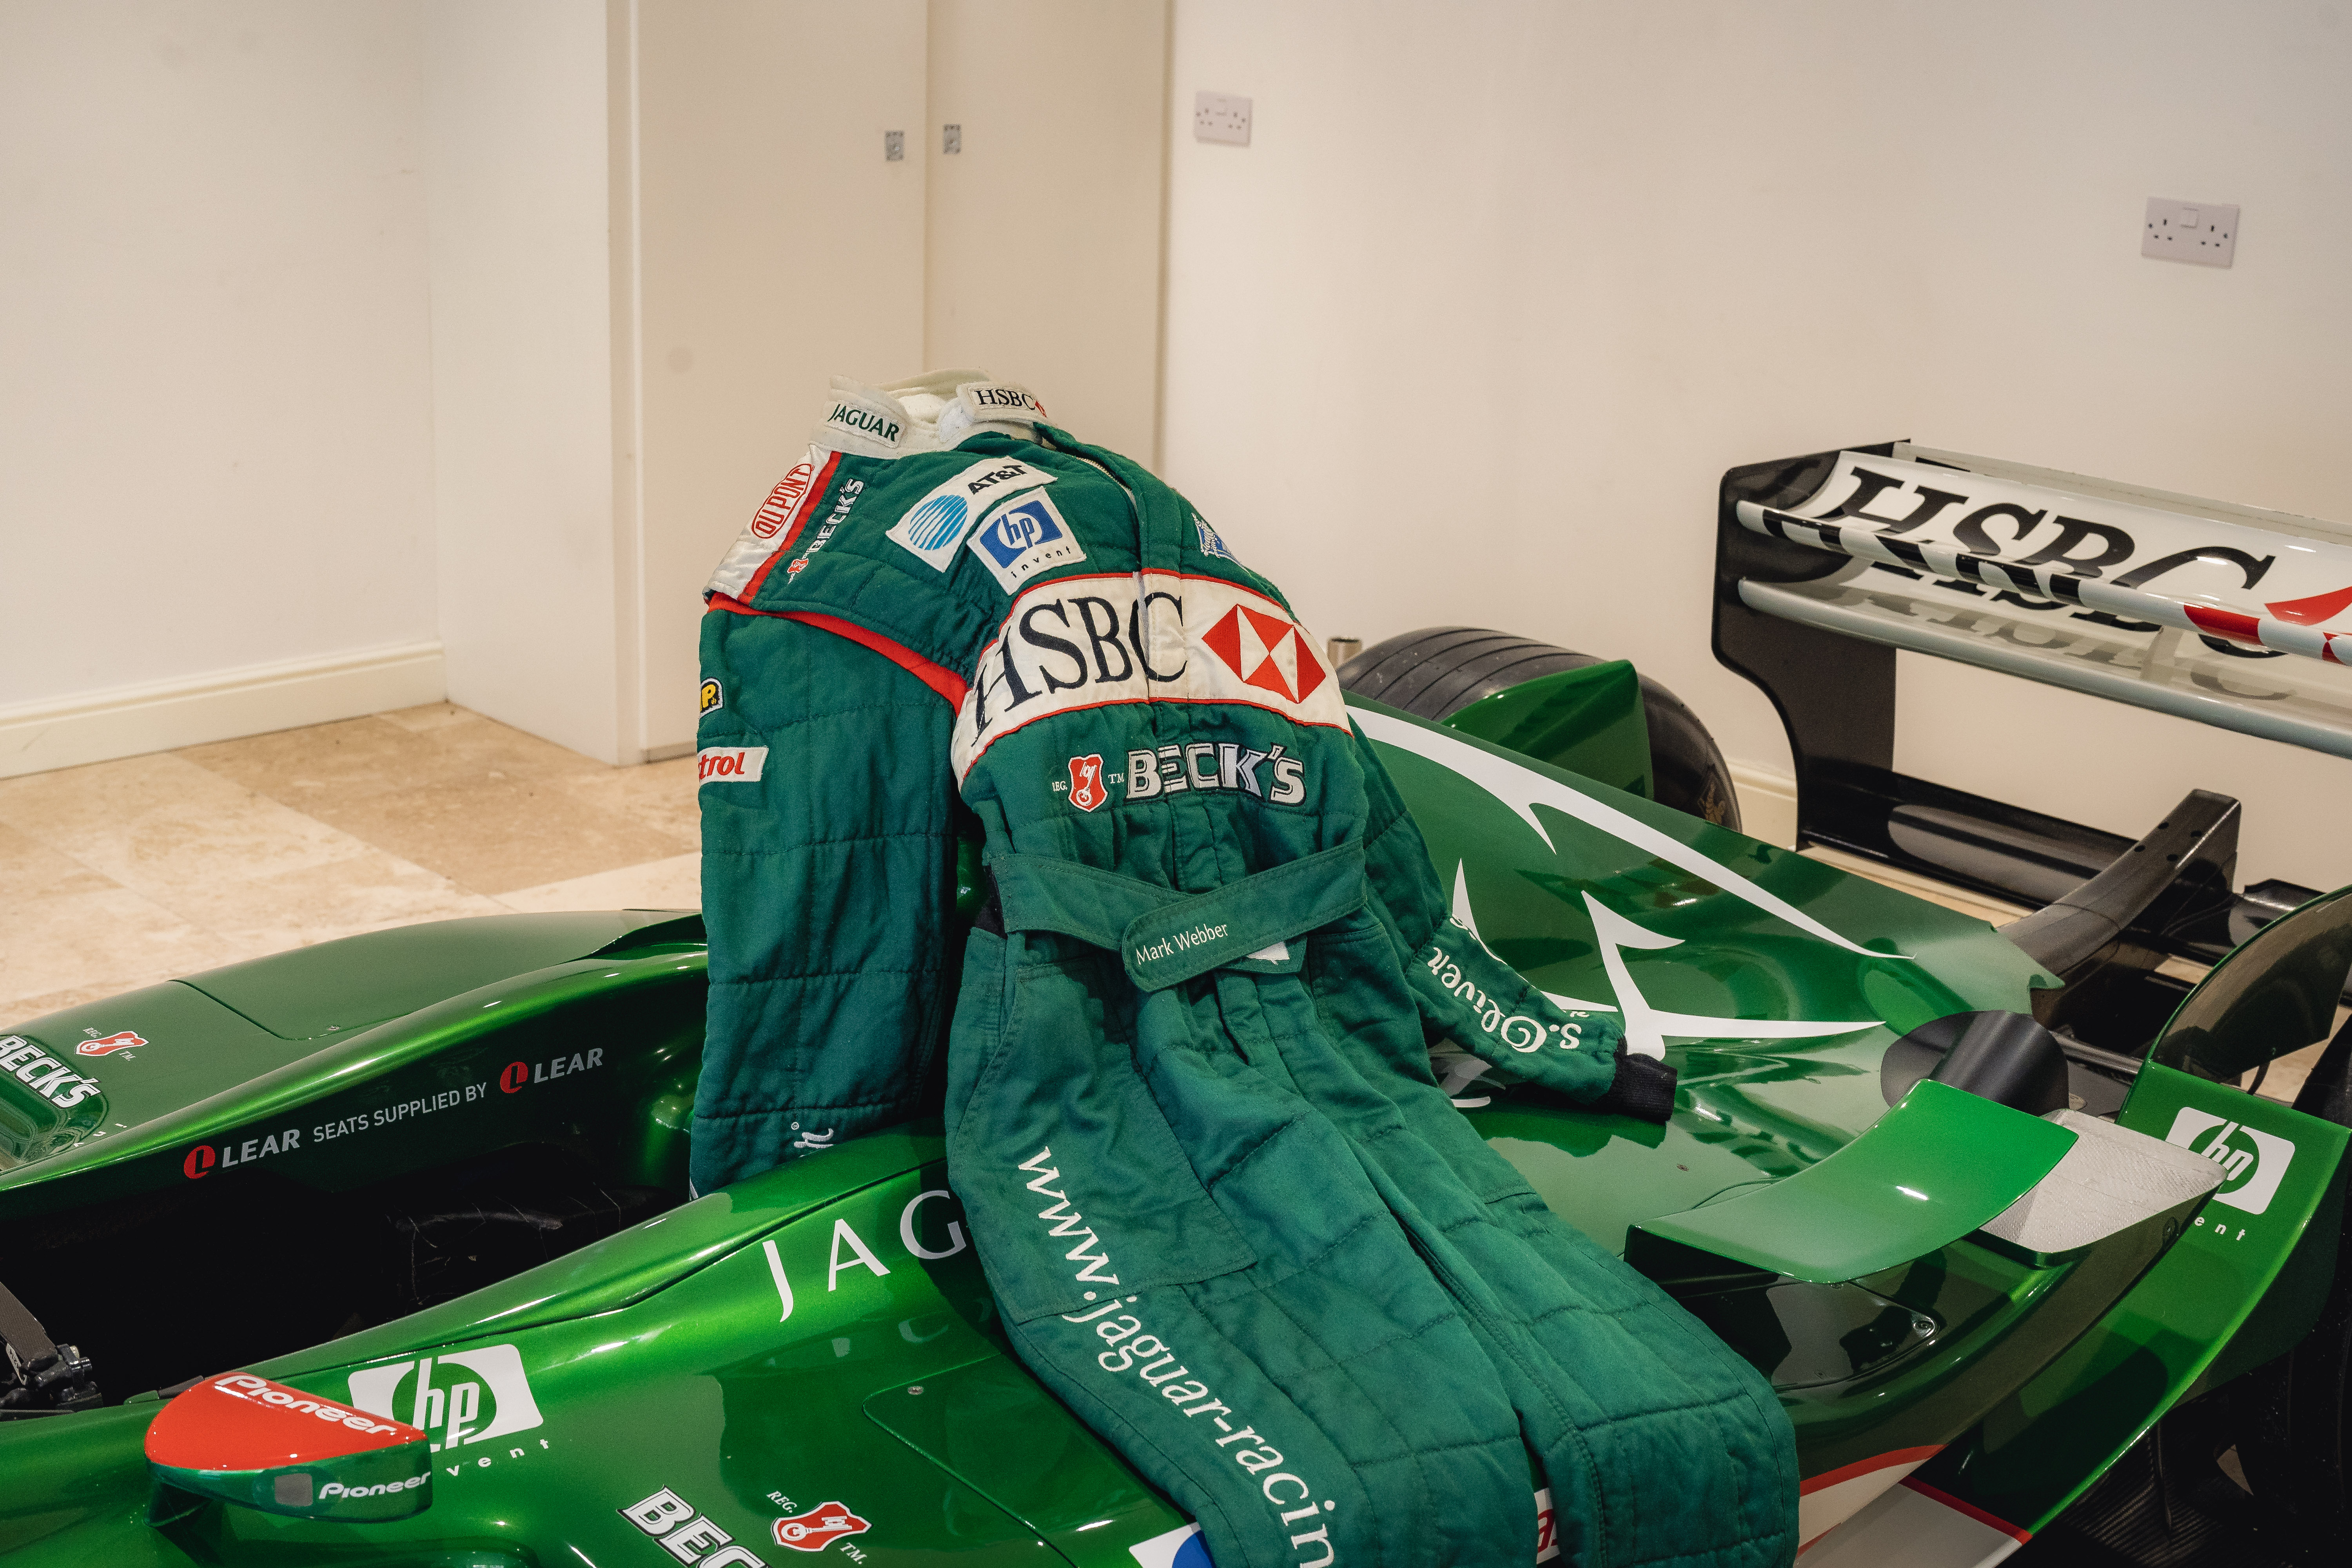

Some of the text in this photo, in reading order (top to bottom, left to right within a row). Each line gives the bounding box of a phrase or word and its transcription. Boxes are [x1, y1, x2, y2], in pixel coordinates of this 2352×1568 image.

[828, 403, 900, 442] JAGUAR
[976, 389, 1036, 412] HSBC
[967, 465, 1027, 495] AT&T
[806, 478, 864, 553] BECK'S
[1001, 514, 1035, 549] hp
[1010, 546, 1071, 578] invent
[1813, 466, 2288, 659] HSBC
[971, 591, 1188, 747] HSBC
[698, 751, 745, 780] trol
[1124, 742, 1307, 807] BECK'S
[1136, 923, 1228, 965] Mark Webber
[1427, 947, 1582, 1053] s.Oliver
[0, 1034, 102, 1110] BECK'S
[222, 1047, 603, 1168] LEAR SEATS SUPPLIED BY LEAR
[762, 1190, 967, 1323] JAG
[214, 1375, 397, 1434] Pioneer
[412, 1357, 480, 1450] hp
[319, 1471, 431, 1500] Pioneer
[766, 1490, 793, 1514] REG.
[840, 1542, 867, 1565] TM.
